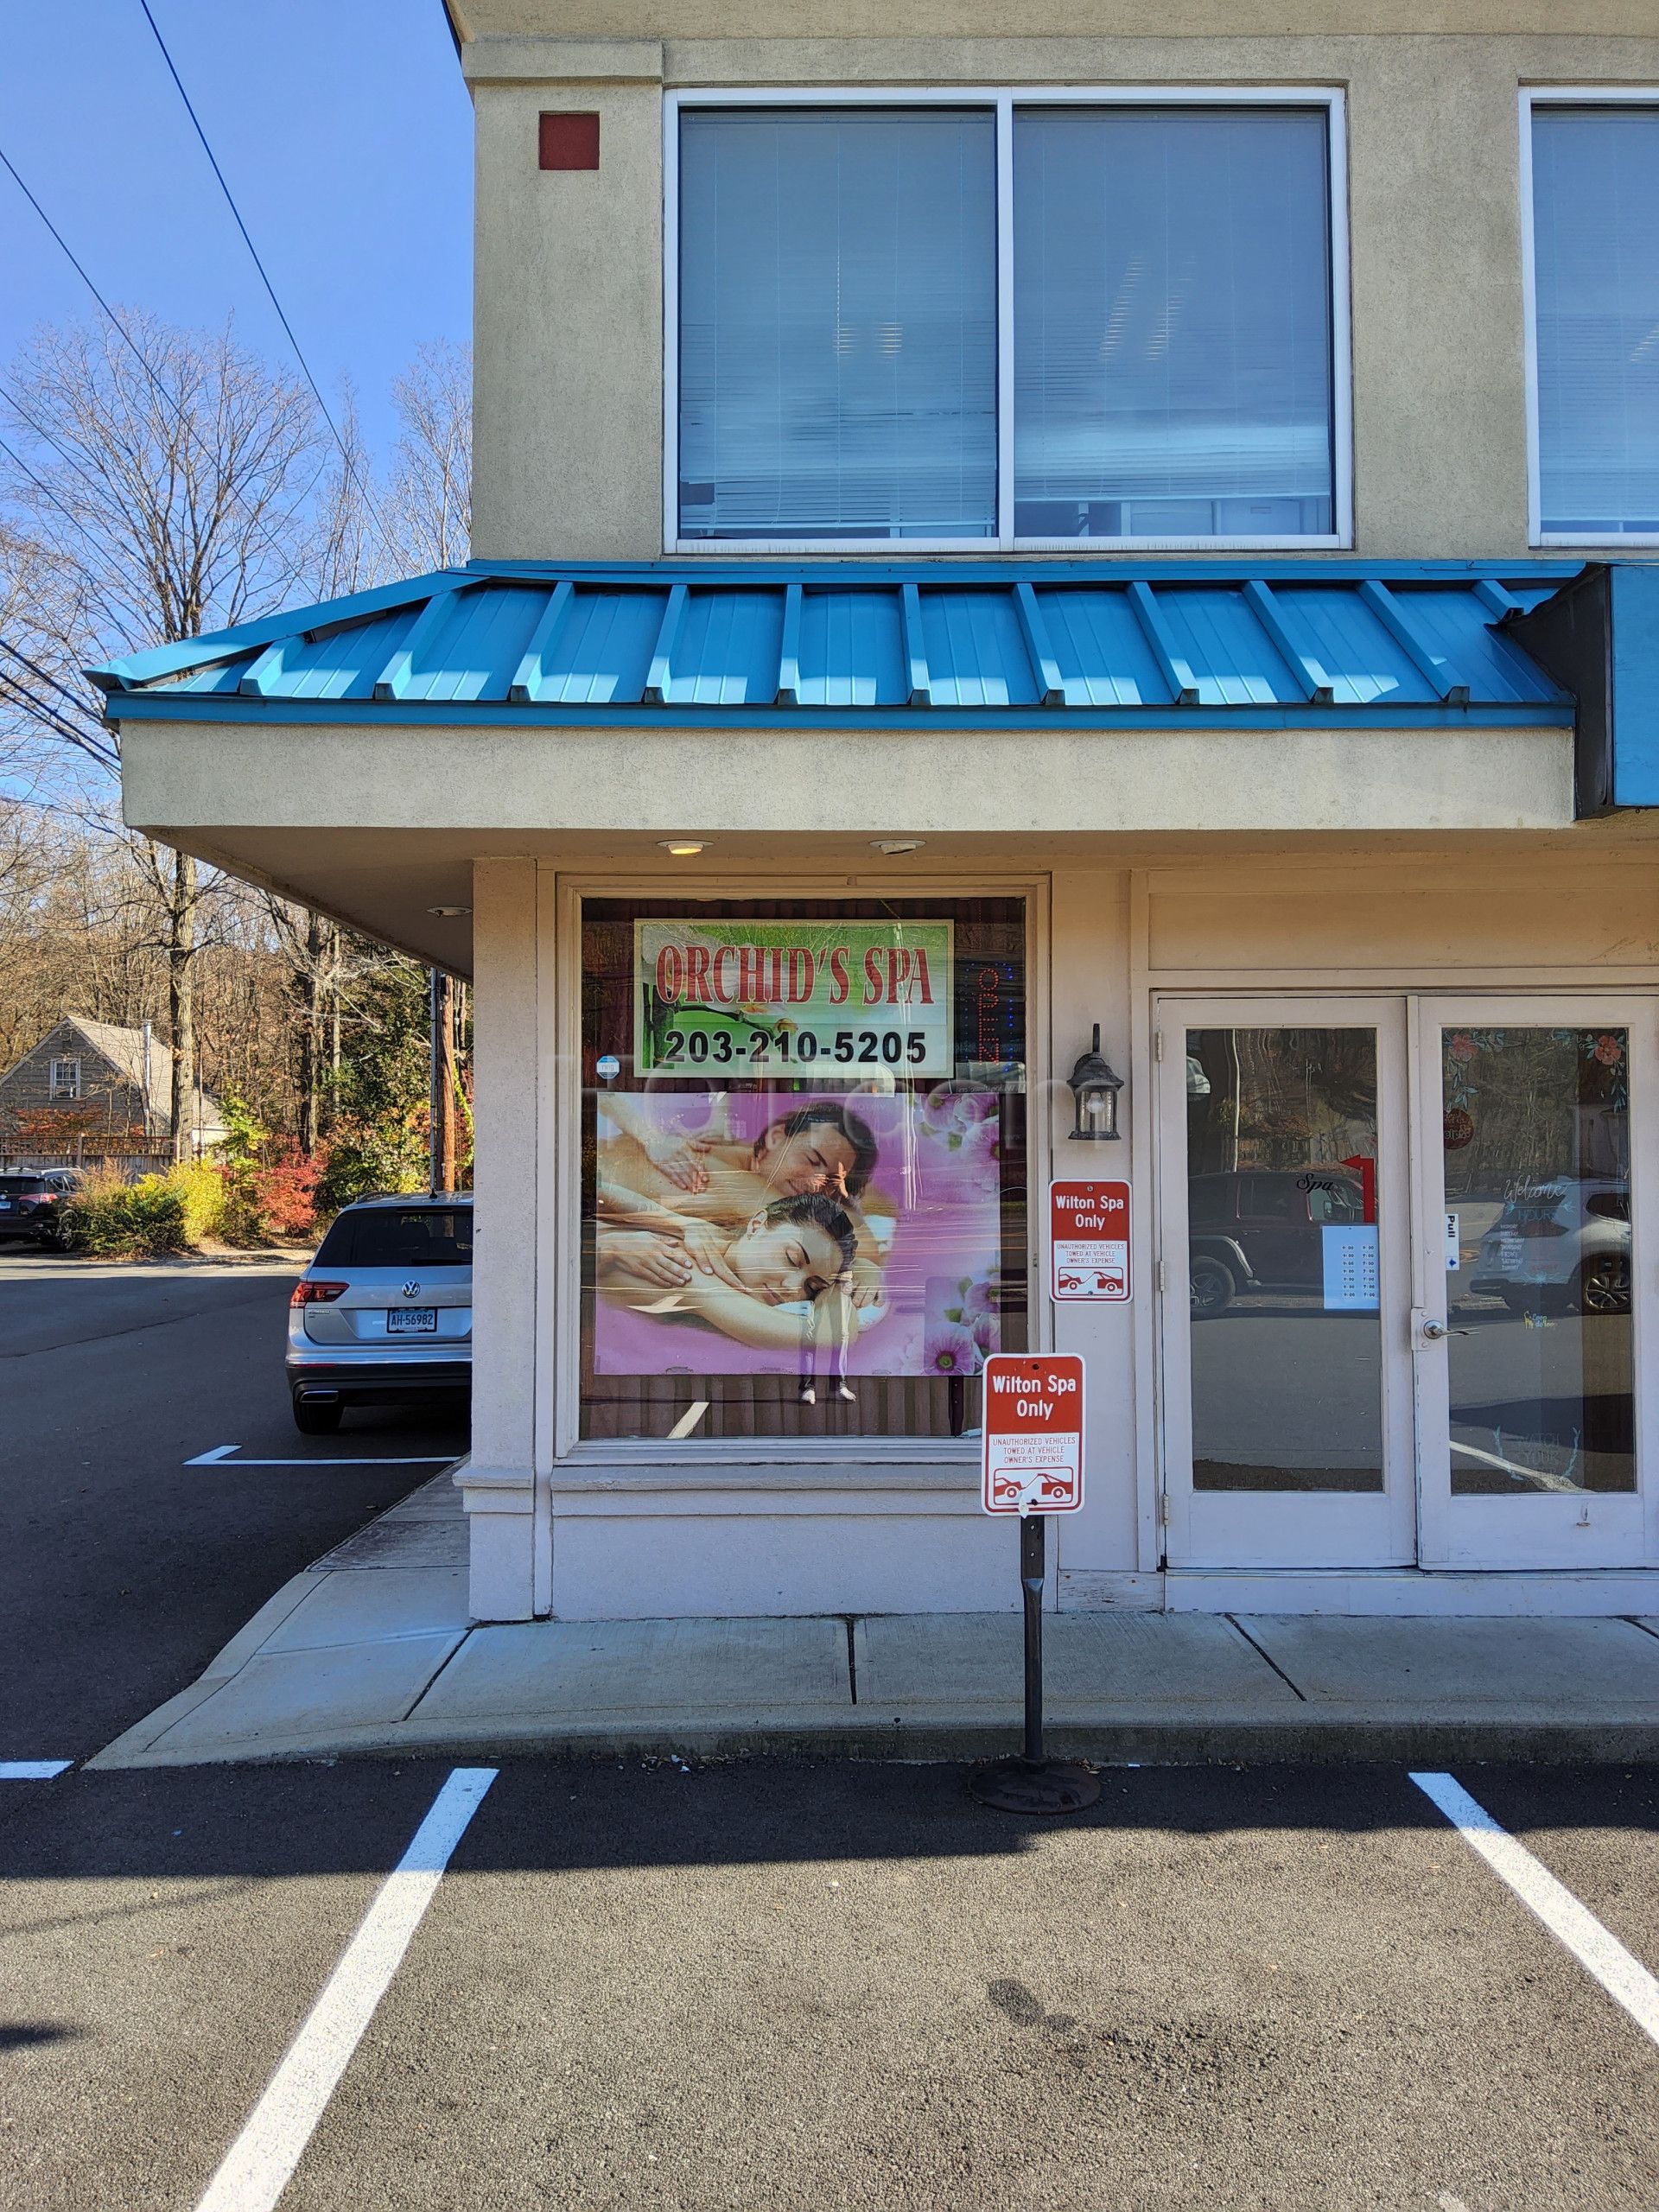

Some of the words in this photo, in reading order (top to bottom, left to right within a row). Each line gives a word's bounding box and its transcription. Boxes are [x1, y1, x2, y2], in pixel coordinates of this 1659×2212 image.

[655, 944, 850, 1005] ORCHID'S
[862, 945, 936, 1005] SPA
[978, 968, 1000, 1065] OPEN
[664, 1030, 926, 1064] 203-210-5205
[1297, 1173, 1334, 1194] Spa
[1504, 1175, 1567, 1203] Welcome
[1056, 1195, 1095, 1209] Wilton
[1100, 1195, 1124, 1212] Spa
[1075, 1214, 1106, 1230] Only
[1447, 1215, 1456, 1238] Pull
[992, 1376, 1041, 1393] Wilton
[1047, 1375, 1076, 1396] Spa
[1017, 1399, 1053, 1421] Only
